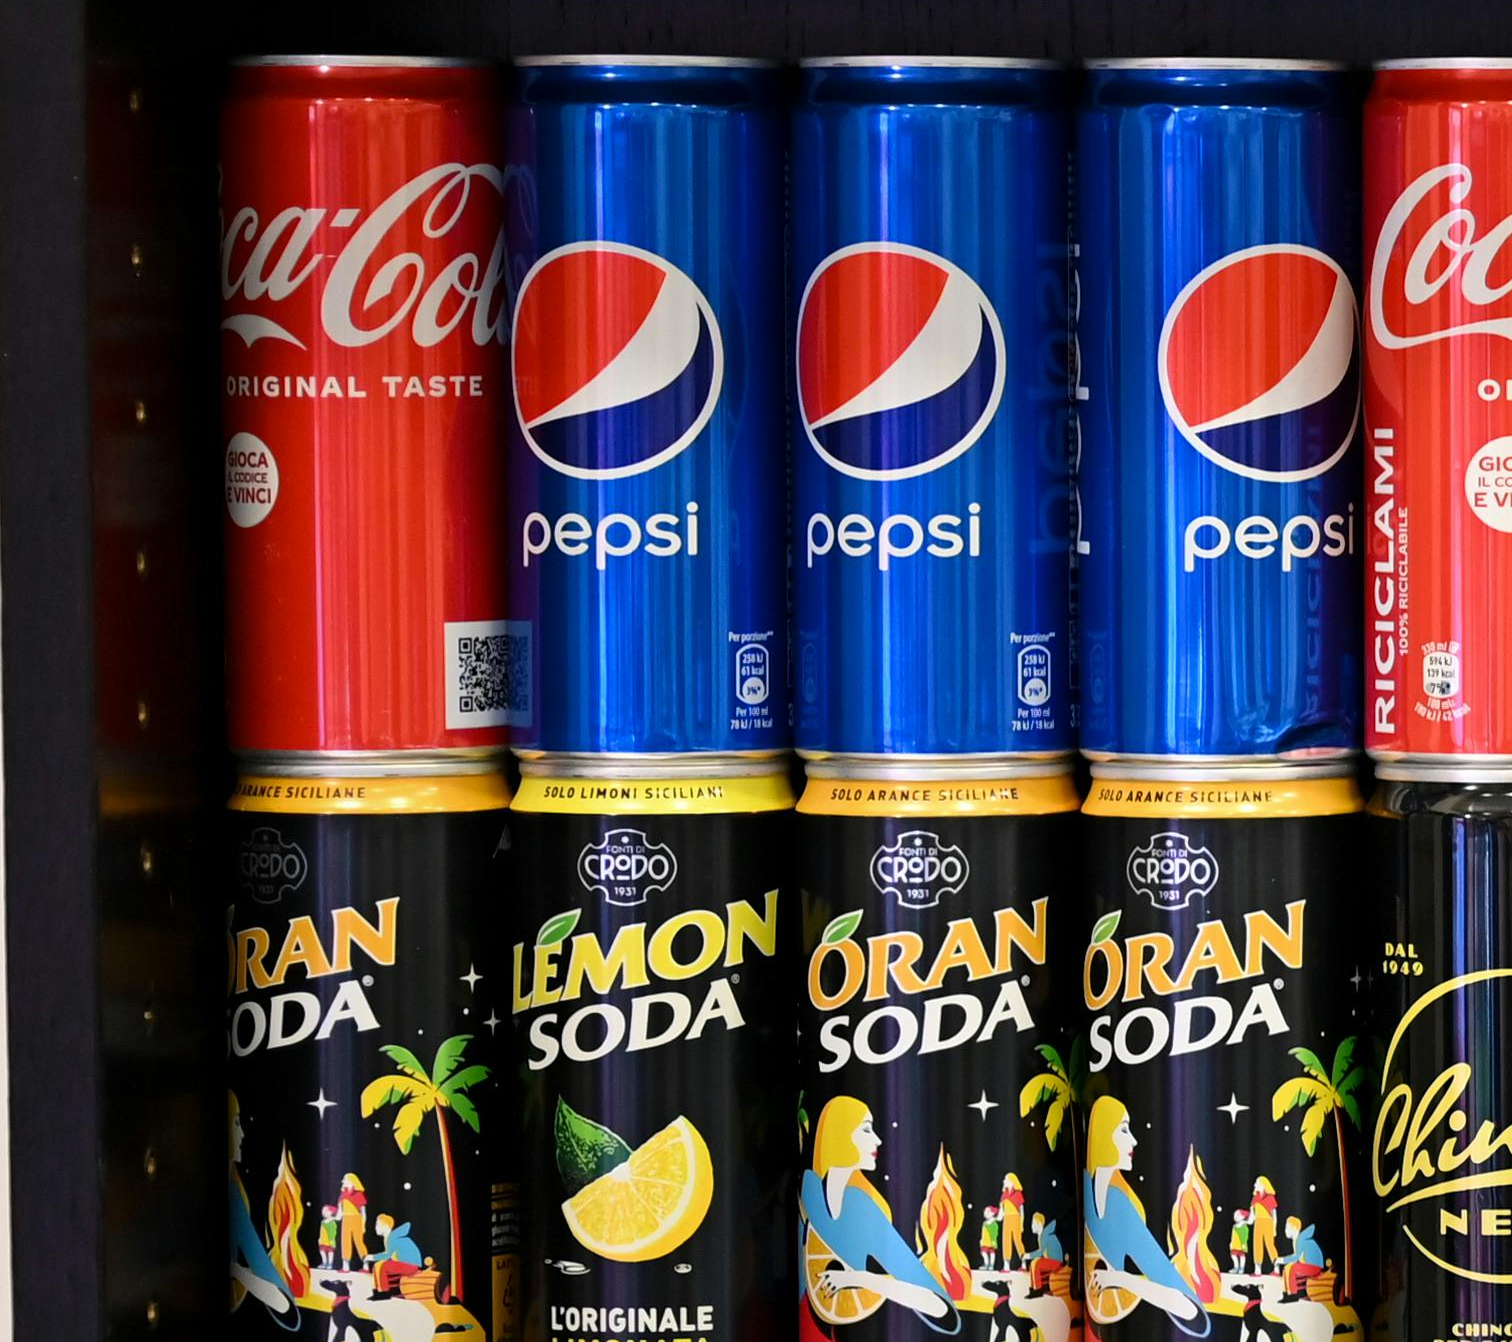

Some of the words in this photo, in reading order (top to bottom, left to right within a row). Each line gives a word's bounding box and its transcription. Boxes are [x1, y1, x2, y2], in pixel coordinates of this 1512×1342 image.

[226, 375, 366, 398] ORIGINAL
[382, 375, 484, 397] TASTE
[1474, 493, 1486, 507] E
[1478, 476, 1491, 486] IL
[523, 501, 699, 570] pepsi
[807, 502, 981, 571] pepsi
[1184, 503, 1354, 572] pepsi
[1399, 507, 1409, 603] RICICLABILE
[1373, 427, 1396, 734] RICICLAMI
[1399, 607, 1409, 657] 100%
[543, 786, 574, 800] SOLO
[580, 787, 638, 800] LIMONI
[644, 787, 723, 800] SICILIANI
[830, 789, 861, 800] SOLO
[868, 788, 932, 801] ARANCE
[937, 788, 1019, 802] SICILIANE
[614, 887, 636, 896] 1931
[908, 889, 929, 898] 1931
[512, 890, 778, 1014] LEMON
[807, 896, 1048, 1011] ORAN
[1382, 960, 1424, 976] 1949
[1385, 943, 1418, 958] DAL
[528, 979, 745, 1070] SODA
[819, 981, 1035, 1073] SODA
[551, 1306, 713, 1332] L'ORIGINALE
